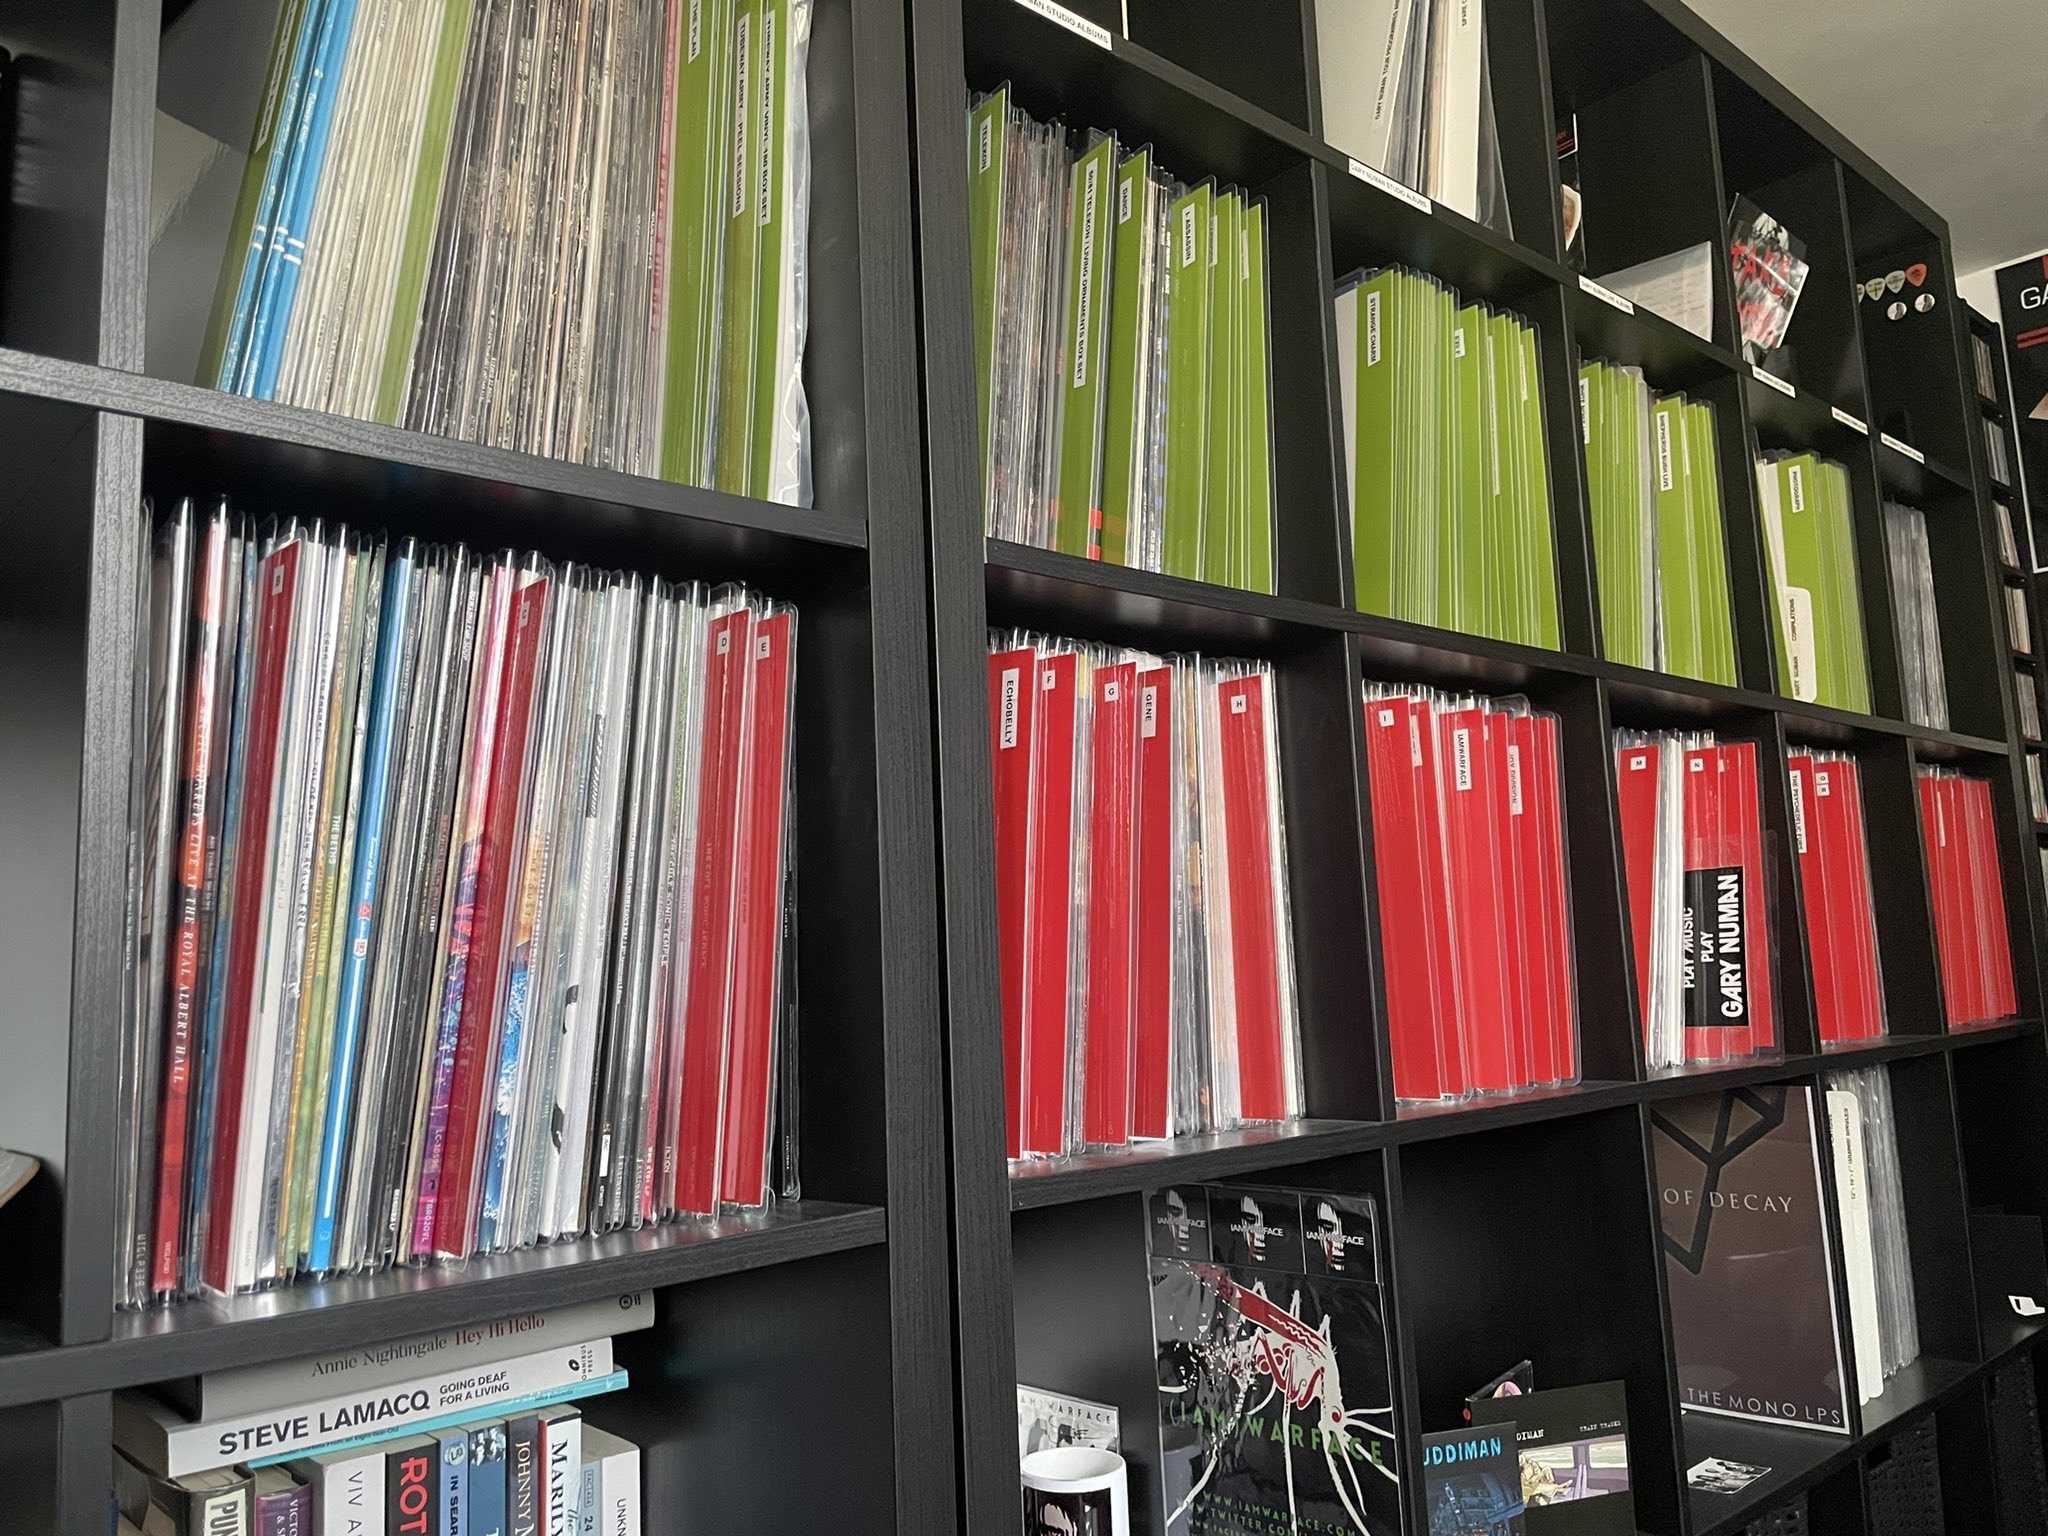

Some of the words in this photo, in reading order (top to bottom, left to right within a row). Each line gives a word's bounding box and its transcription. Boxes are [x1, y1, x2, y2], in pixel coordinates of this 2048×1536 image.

[1046, 5, 1076, 27] STUDIO
[1077, 22, 1109, 45] ALBUMS
[735, 154, 743, 213] SESSIONS
[1350, 162, 1366, 178] GARY
[1085, 196, 1093, 239] TELEKON
[1082, 247, 1090, 278] LIVING
[1079, 279, 1088, 338] ORNAMENTS
[1077, 340, 1085, 360] BOX
[1004, 680, 1014, 745] ECHOBELLY
[1144, 693, 1153, 723] GENE
[1457, 733, 1468, 787] IAMWARFACE
[191, 758, 207, 826] MONKEYS
[1510, 769, 1518, 805] DIVISION
[332, 814, 342, 833] THE
[188, 832, 202, 869] LIVE
[328, 833, 339, 865] BETHS
[187, 871, 199, 891] AT
[324, 875, 335, 913] FUTURE
[525, 883, 534, 917] DUST
[184, 893, 196, 925] THE
[664, 891, 674, 924] SONIC
[1717, 874, 1740, 954] NUMAN
[660, 926, 671, 968] TEMPLE
[1684, 907, 1694, 954] MUSIC
[1700, 931, 1714, 963] PLAY
[178, 930, 194, 977] ROYAL
[1684, 959, 1696, 989] PLAY
[1719, 959, 1744, 1018] GARY
[176, 982, 190, 1039] ALBERT
[172, 1045, 187, 1085] HALL
[1664, 1188, 1694, 1206] OF
[1709, 1191, 1792, 1213] DECAY
[421, 1199, 434, 1243] TBR020VL
[311, 1355, 358, 1378] Annie
[363, 1334, 447, 1368] Nightingale
[455, 1328, 485, 1347] Hey
[489, 1320, 504, 1339] Hi
[508, 1314, 546, 1335] Hello
[439, 1378, 476, 1395] GOING
[478, 1370, 507, 1387] DEAF
[439, 1393, 463, 1407] FOR
[465, 1390, 473, 1401] A
[475, 1381, 510, 1398] LIVING
[219, 1416, 309, 1456] STEVE
[319, 1389, 431, 1434] LAMACQ
[1687, 1387, 1722, 1407] THE
[1729, 1395, 1797, 1418] MONO
[1805, 1405, 1841, 1425] LPS
[1516, 1429, 1545, 1442] DIMAN
[1579, 1424, 1598, 1433] TRAIN
[347, 1470, 363, 1506] VIV
[400, 1456, 428, 1535] ROT
[451, 1474, 458, 1490] IN
[515, 1439, 532, 1520] JOHNNY
[450, 1492, 459, 1536] SEAR
[584, 1515, 593, 1532] 24
[616, 1498, 626, 1536] UNKN
